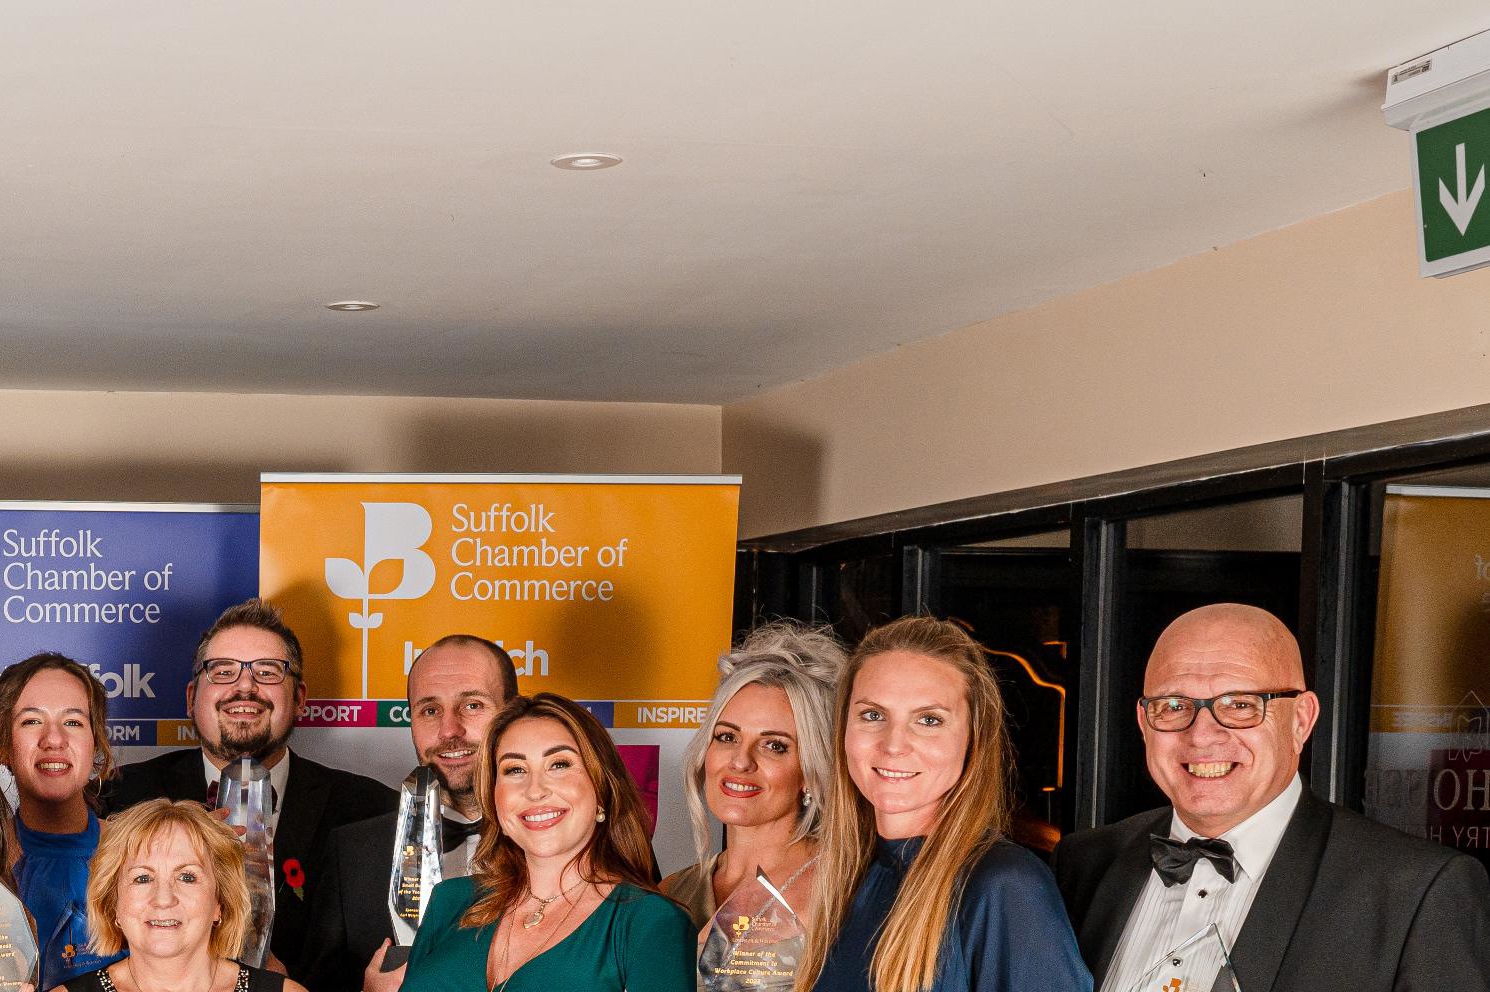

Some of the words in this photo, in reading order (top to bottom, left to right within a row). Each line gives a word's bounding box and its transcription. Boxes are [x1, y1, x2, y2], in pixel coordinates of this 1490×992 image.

[451, 503, 555, 533] Suffolk
[3, 529, 103, 558] Suffolk
[451, 538, 589, 568] Chamber
[598, 538, 628, 568] of
[3, 562, 135, 591] Chamber
[144, 563, 173, 591] of
[451, 572, 614, 601] Commerce
[3, 596, 161, 624] Commerce
[297, 705, 361, 722] PPORT
[638, 707, 708, 723] INSPIRE
